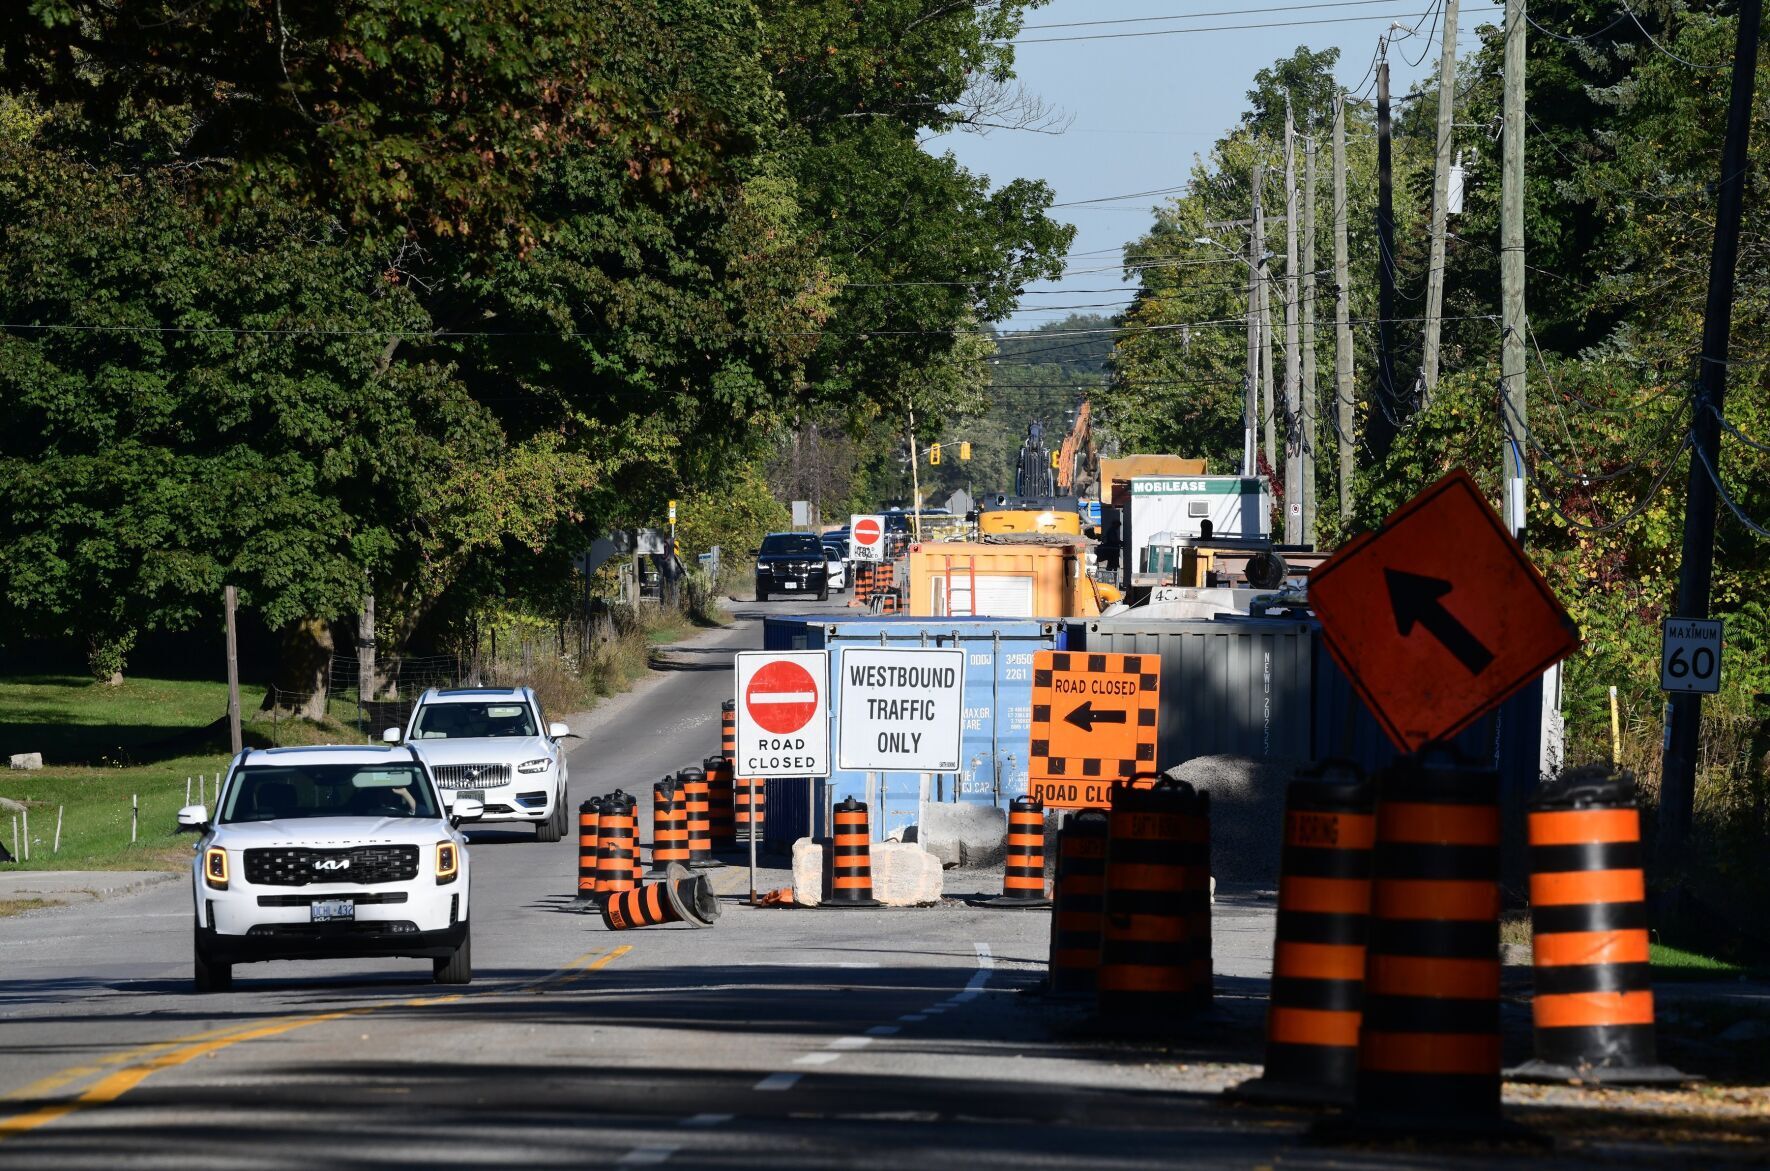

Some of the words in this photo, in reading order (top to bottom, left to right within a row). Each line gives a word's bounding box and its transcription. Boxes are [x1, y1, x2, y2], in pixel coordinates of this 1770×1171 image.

[1133, 481, 1206, 493] MOBILEASE
[1669, 626, 1717, 640] MAXIMUM
[1263, 652, 1271, 693] NEWU
[1667, 646, 1715, 680] 60
[850, 665, 955, 688] WESTBOUND
[1055, 679, 1086, 694] ROAD
[1091, 680, 1136, 695] CLOSED
[867, 699, 935, 721] TRAFFIC
[758, 738, 805, 751] ROAD
[877, 732, 922, 754] ONLY
[748, 757, 816, 769] CLOSED
[1035, 784, 1078, 802] ROAD
[1085, 785, 1113, 803] CLO
